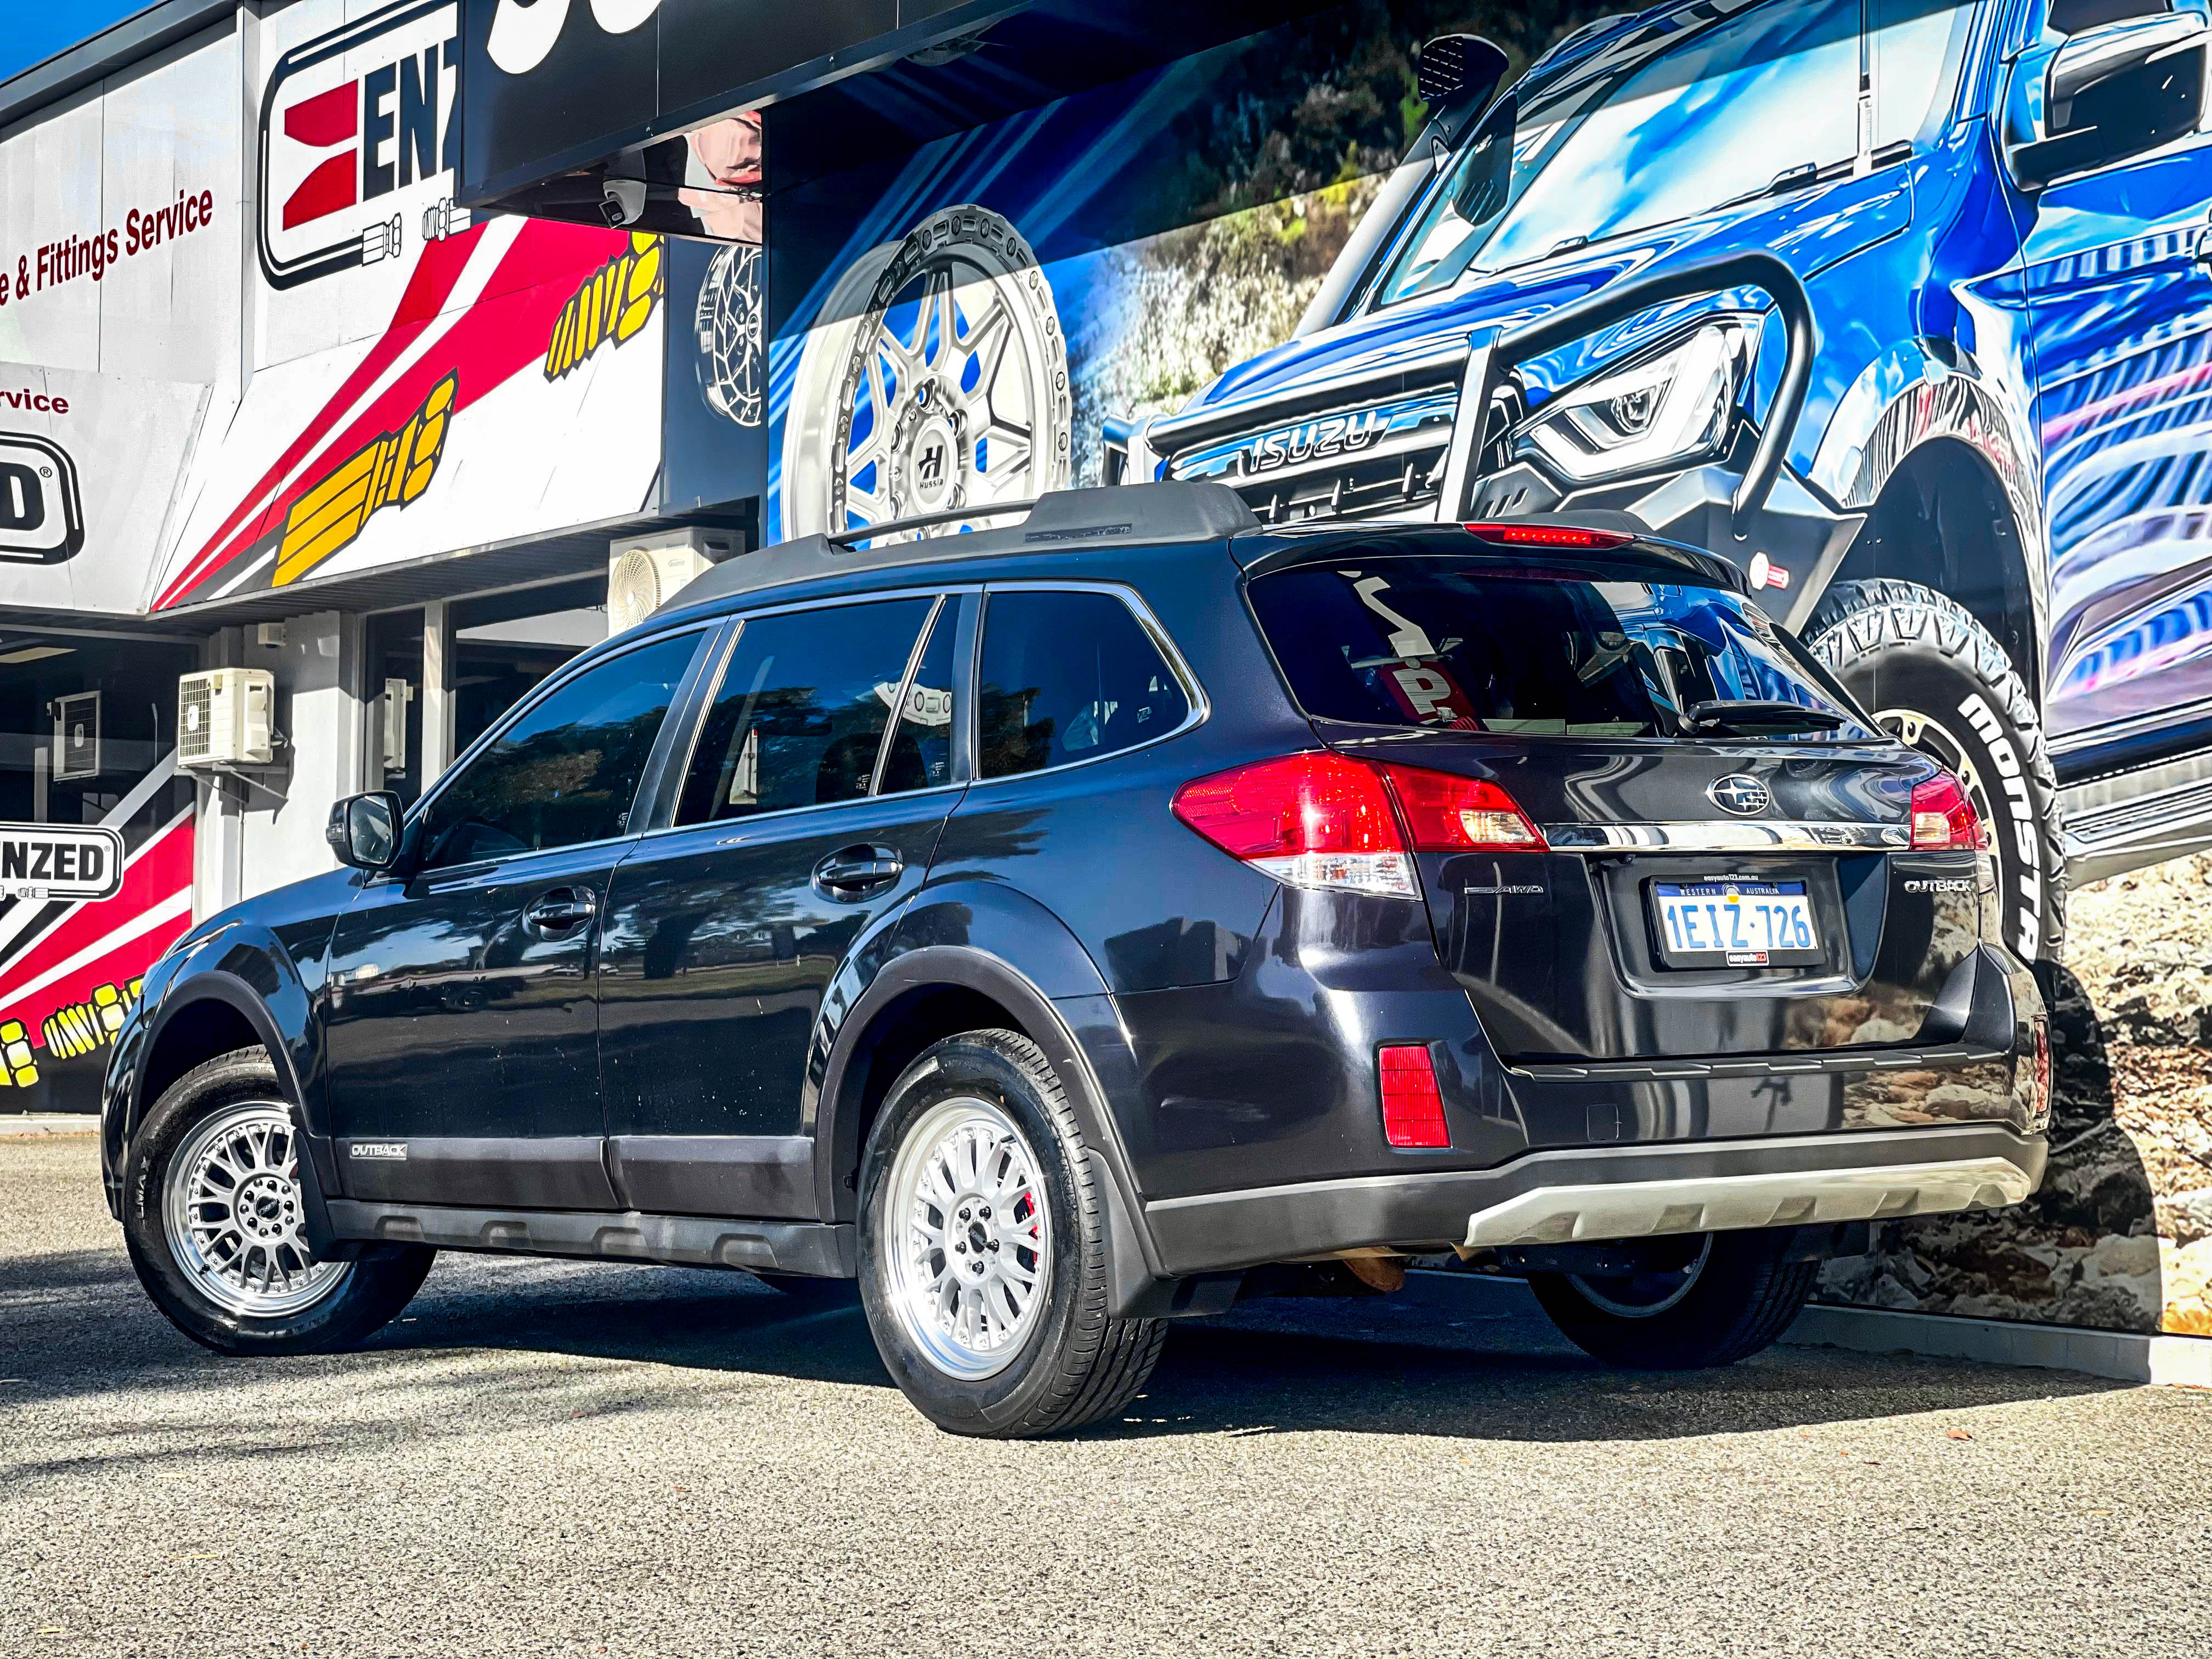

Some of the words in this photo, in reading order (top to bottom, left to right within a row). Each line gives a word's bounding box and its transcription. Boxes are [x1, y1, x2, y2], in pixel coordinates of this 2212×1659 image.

[16, 255, 30, 300] &
[37, 228, 119, 291] Fittings
[126, 189, 213, 256] Service
[1250, 410, 1376, 473] ISUZU
[1703, 874, 1759, 883] easyauto123.com.au
[1746, 887, 1780, 895] AUSTRALIA
[1904, 879, 1972, 893] OUTBACK
[1729, 953, 1767, 963] easyauto123
[352, 1144, 407, 1156] OUTBACK
